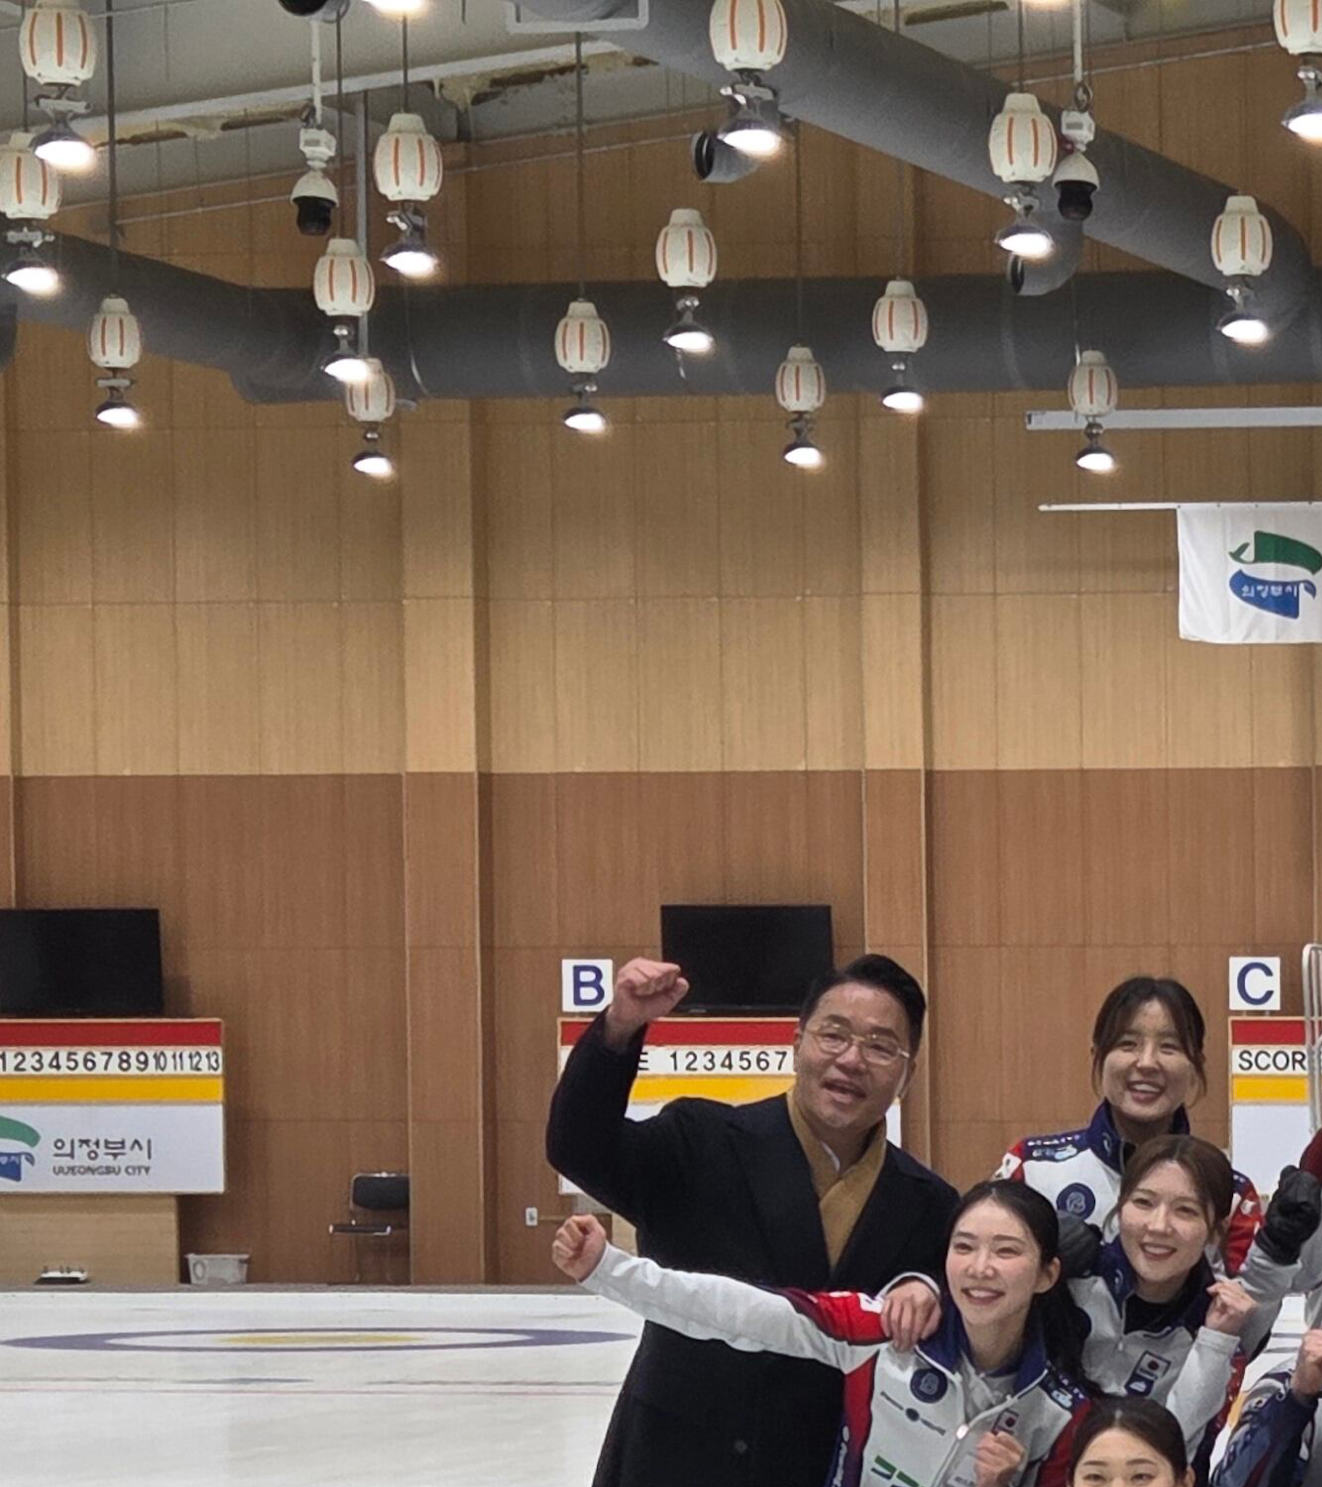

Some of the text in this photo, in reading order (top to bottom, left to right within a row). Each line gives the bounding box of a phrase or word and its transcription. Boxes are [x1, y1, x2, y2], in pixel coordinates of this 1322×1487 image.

[571, 965, 605, 1007] B
[1236, 961, 1275, 1007] C
[1237, 1050, 1307, 1072] SCOR
[52, 1137, 152, 1161] 의정부시
